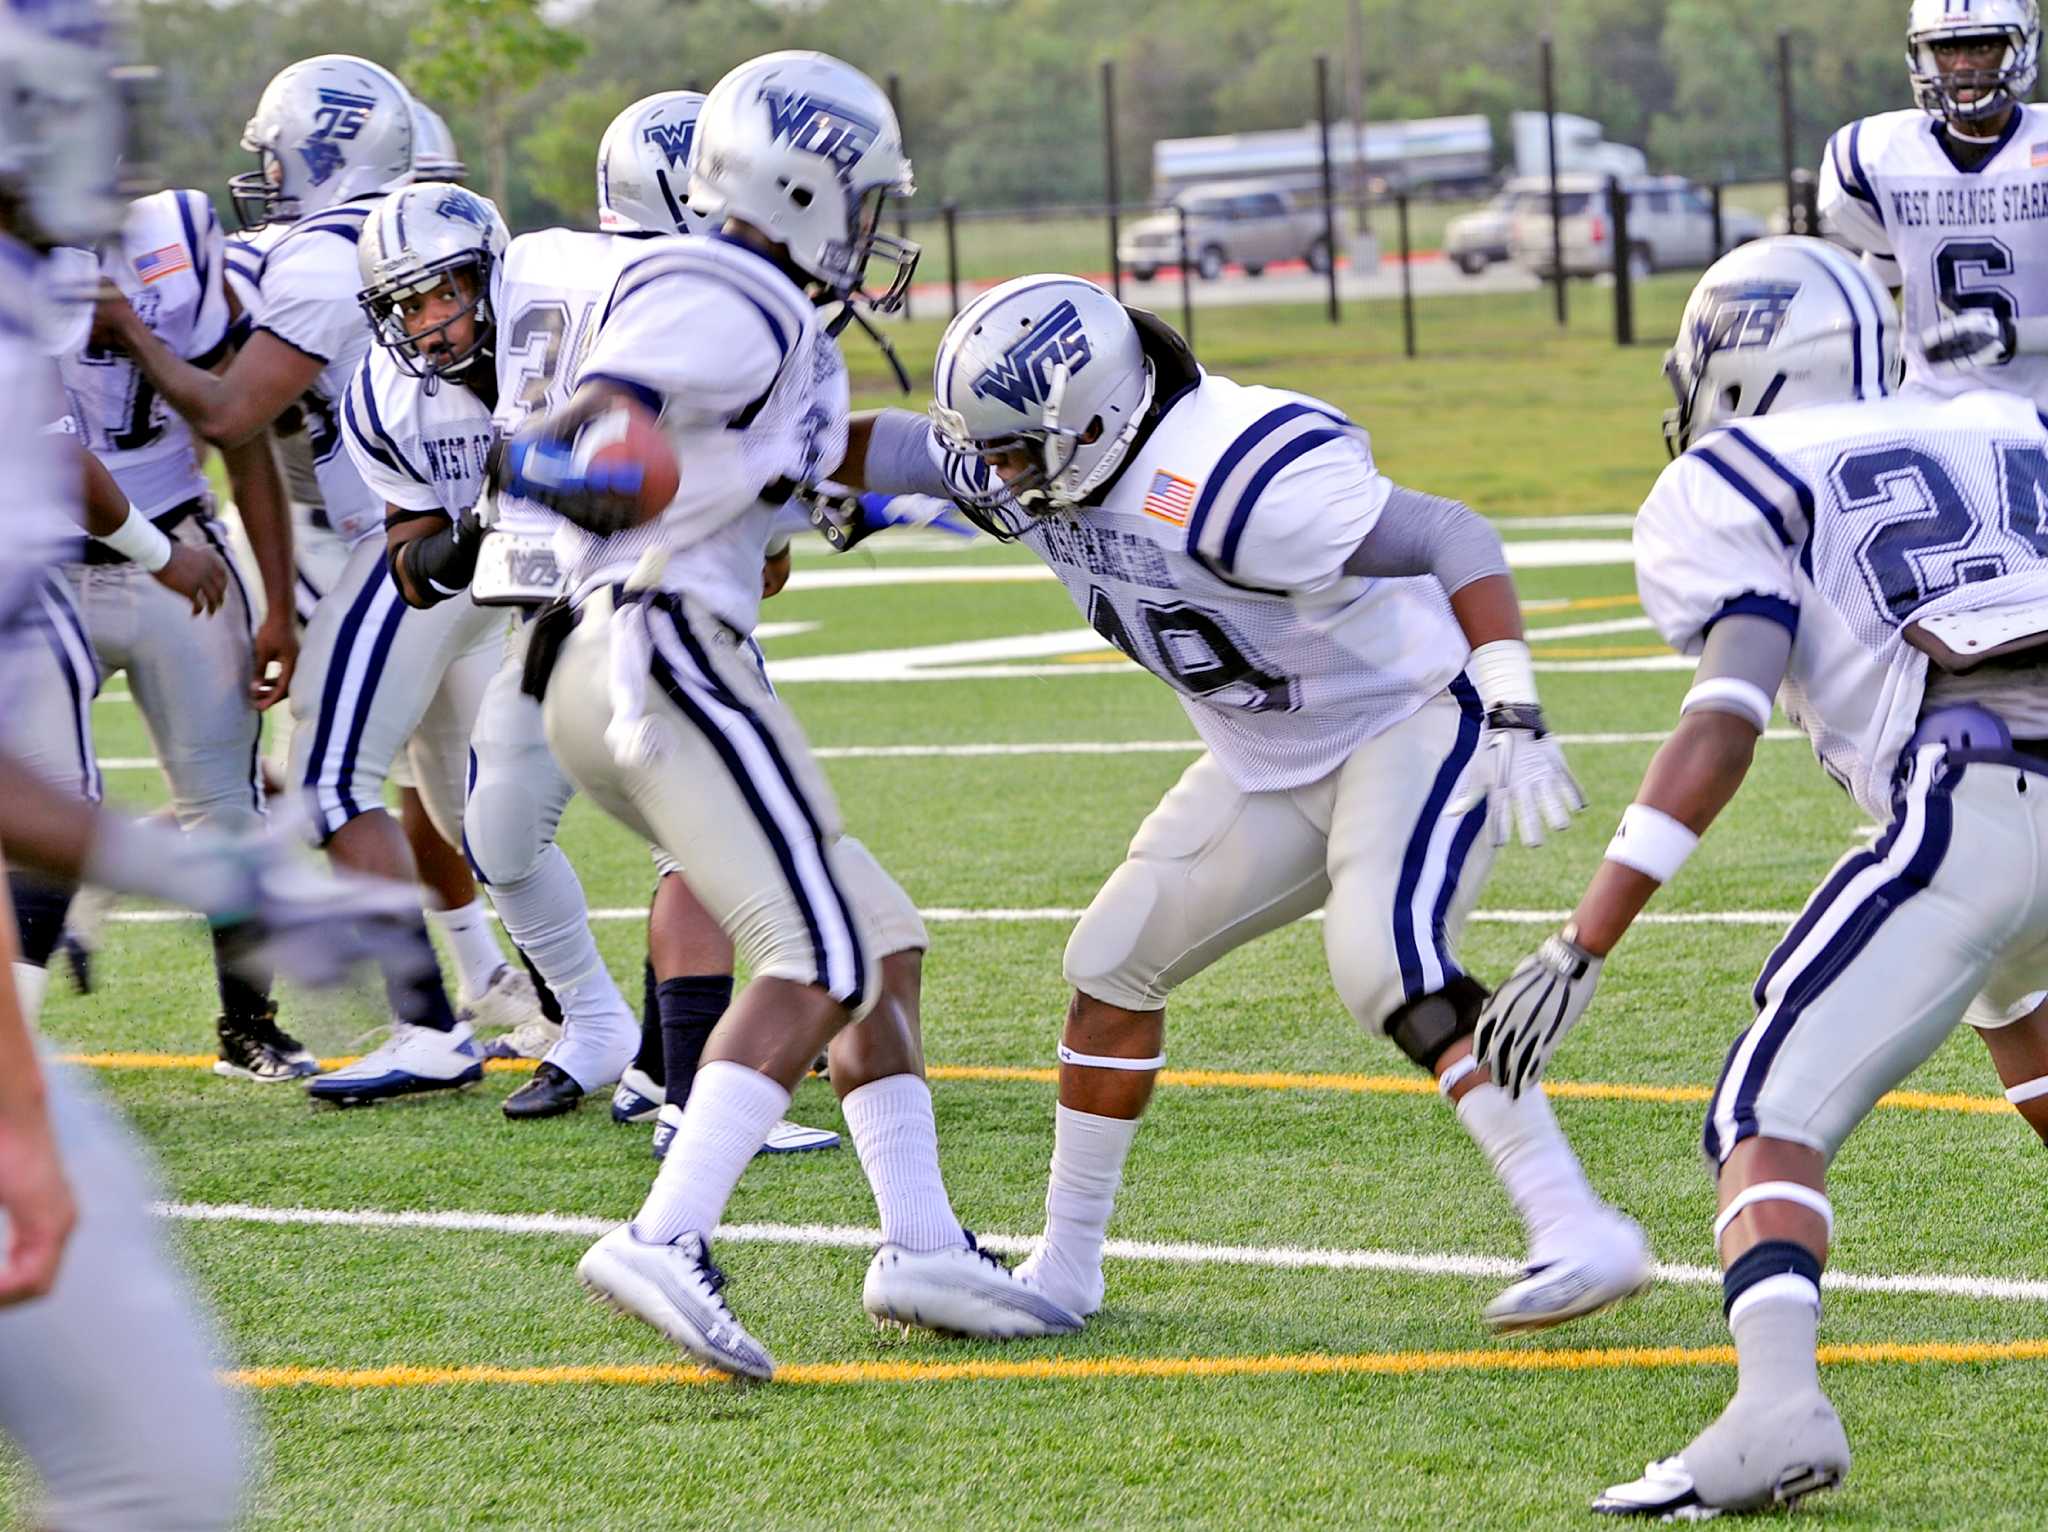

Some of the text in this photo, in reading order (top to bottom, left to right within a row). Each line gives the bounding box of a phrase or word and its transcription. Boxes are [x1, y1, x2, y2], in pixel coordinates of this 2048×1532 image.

[1890, 189, 1930, 227] WEST
[1935, 187, 1997, 227] ORANGE
[969, 299, 1092, 416] WOS
[422, 436, 471, 482] WEST
